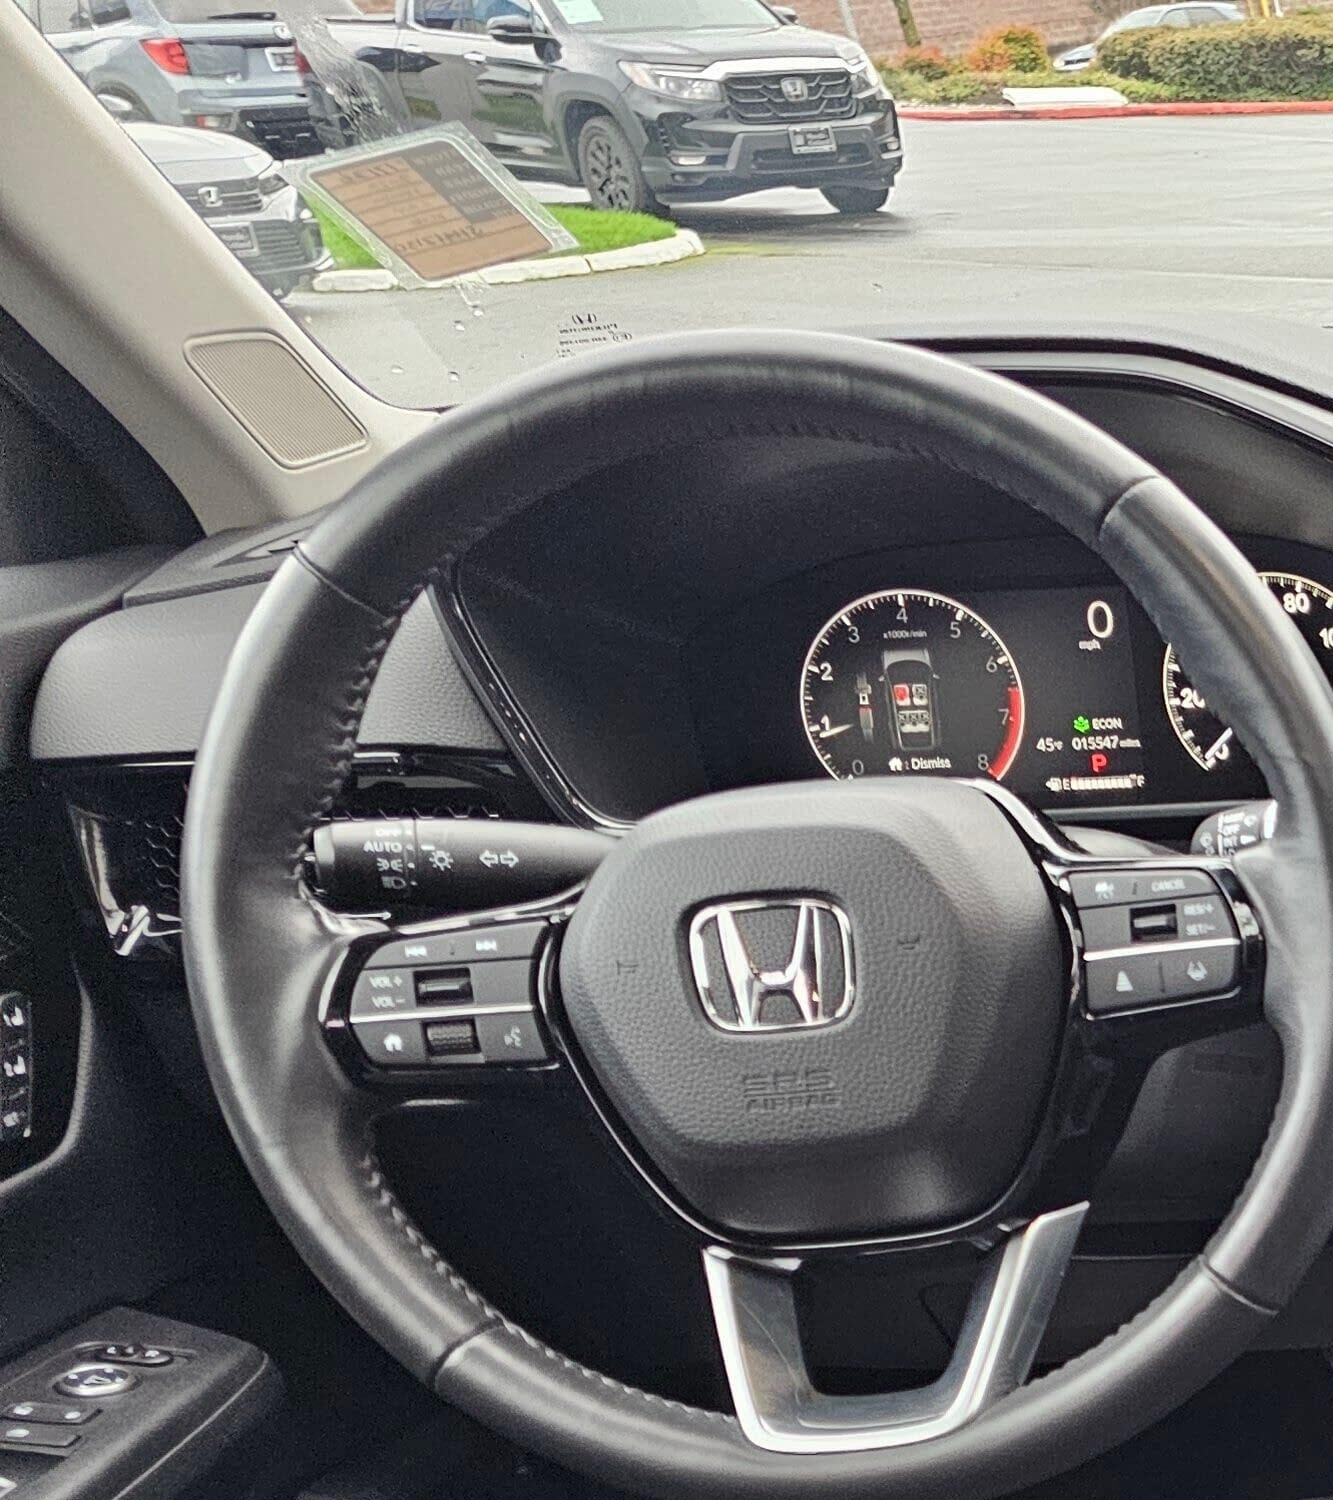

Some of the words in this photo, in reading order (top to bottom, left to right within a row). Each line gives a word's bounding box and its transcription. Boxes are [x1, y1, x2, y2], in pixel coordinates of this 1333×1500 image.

[1282, 592, 1310, 614] 80
[896, 607, 908, 624] 4
[1086, 600, 1115, 639] 0
[848, 626, 860, 643] 3
[883, 629, 928, 641] x1000r/min
[950, 621, 961, 639] 5
[1078, 638, 1101, 651] mph
[820, 662, 834, 682] 2
[985, 656, 998, 673] 6
[820, 714, 831, 731] 1
[997, 708, 1009, 725] 7
[1091, 717, 1123, 730] ECON
[1071, 734, 1120, 751] 015547
[852, 759, 865, 776] 0
[910, 756, 952, 770] Dismiss
[977, 753, 989, 771] 8
[1090, 753, 1108, 773] P
[363, 841, 402, 854] AUTO
